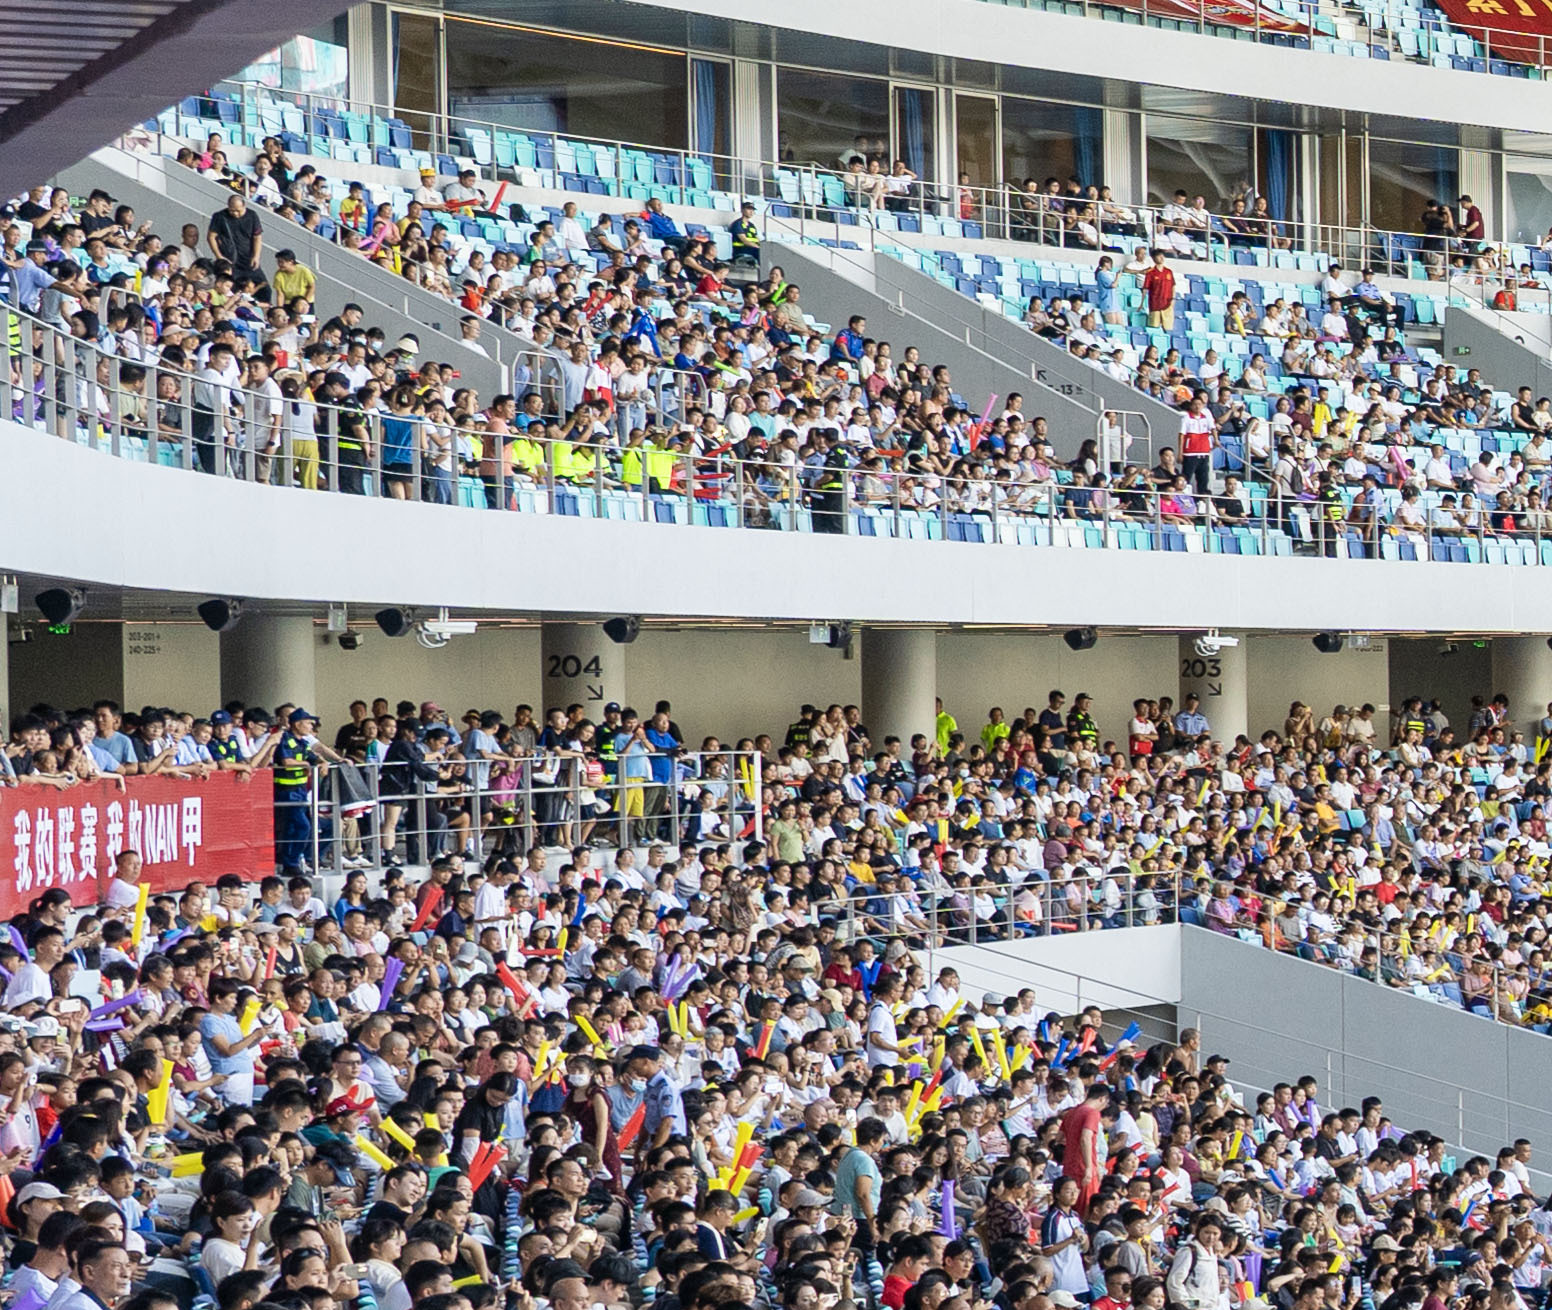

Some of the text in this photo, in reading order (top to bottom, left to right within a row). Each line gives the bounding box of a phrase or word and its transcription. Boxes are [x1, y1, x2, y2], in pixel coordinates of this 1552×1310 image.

[548, 660, 602, 678] 204
[1182, 659, 1221, 677] 203
[14, 803, 98, 893] 我的联赛
